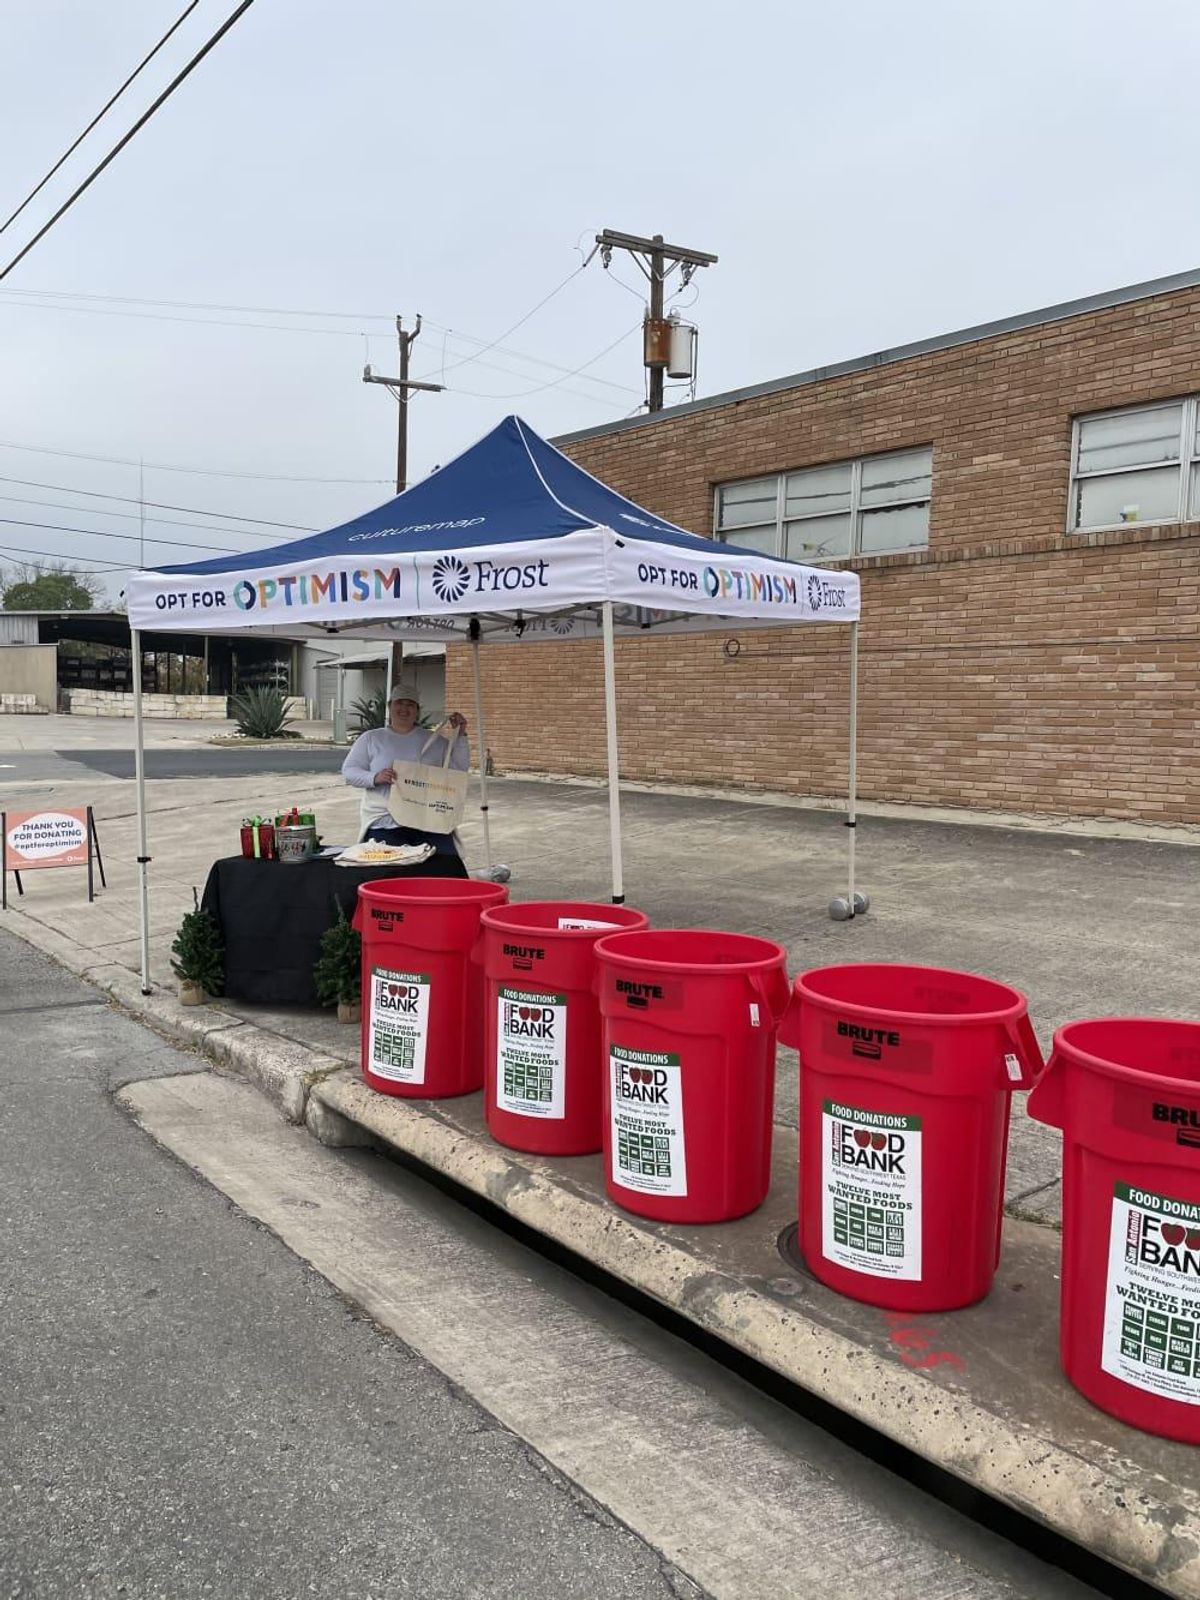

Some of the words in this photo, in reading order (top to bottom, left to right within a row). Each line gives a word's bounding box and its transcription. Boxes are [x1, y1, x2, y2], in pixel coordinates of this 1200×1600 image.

[348, 516, 485, 541] culturemap
[474, 559, 549, 592] Frost
[638, 564, 667, 585] OPT
[671, 570, 699, 590] FOR
[703, 566, 797, 604] OPTIMISM
[156, 593, 187, 609] OPT
[192, 591, 226, 608] FOR
[233, 567, 401, 611] OPTIMISM
[822, 581, 846, 608] Frost
[14, 832, 32, 841] FOR
[34, 829, 82, 839] DONATING
[22, 822, 53, 831] THANK
[54, 820, 74, 829] YOU
[371, 908, 404, 922] BRUTE
[503, 944, 544, 959] BRUTE
[504, 988, 519, 1000] FOOD
[519, 992, 557, 1004] DONATIONS
[616, 979, 662, 998] BRUTE
[380, 994, 418, 1013] BANK
[510, 1019, 554, 1039] BANK
[837, 1021, 900, 1046] BRUTE
[530, 1056, 559, 1066] FOODS
[531, 1051, 551, 1059] MOST
[628, 1051, 669, 1064] DONATIONS
[622, 1081, 669, 1104] BANK
[644, 1120, 666, 1128] MOST
[831, 1104, 852, 1119] FOOD
[853, 1110, 907, 1128] DONATIONS
[645, 1127, 676, 1136] FOODS
[841, 1144, 906, 1174] BANK
[828, 1184, 871, 1204] WANTED
[873, 1199, 913, 1210] FOODS
[835, 1180, 870, 1196] TWELVE
[872, 1190, 901, 1200] MOST
[1129, 1188, 1160, 1209] FOOD
[1163, 1200, 1200, 1219] DONA
[1116, 1285, 1178, 1314] WANTED
[1129, 1281, 1179, 1305] TWELVE
